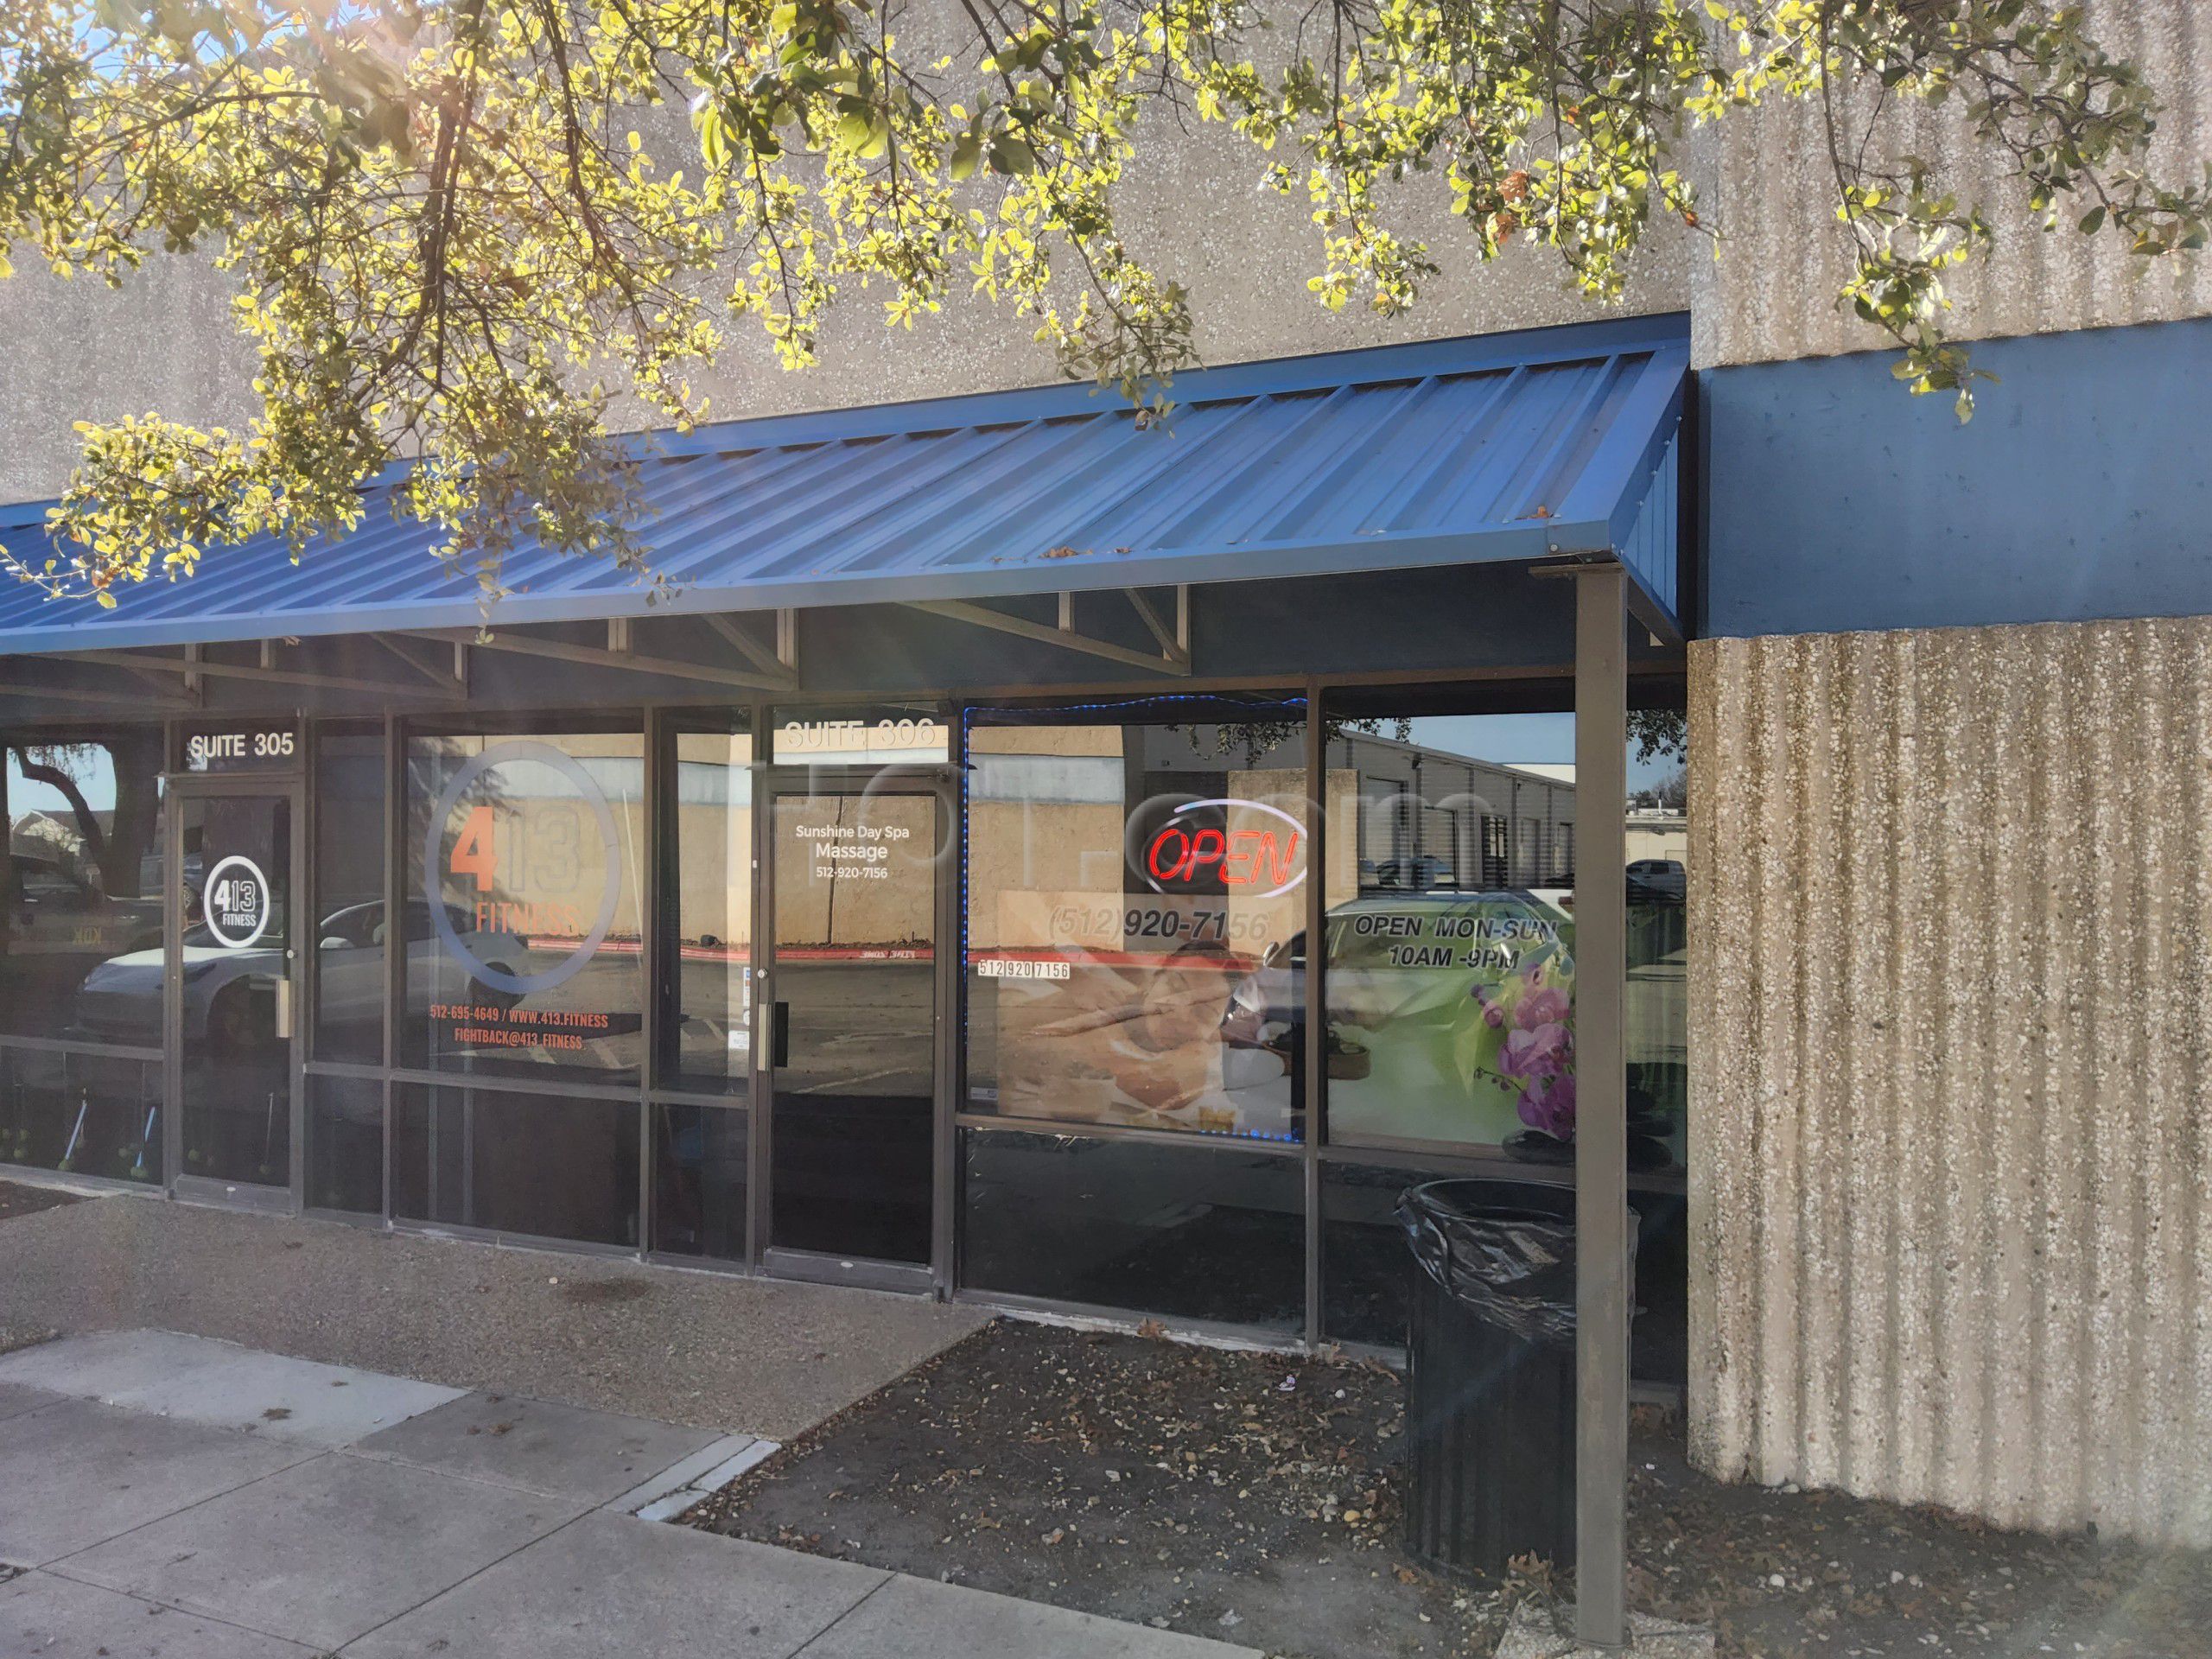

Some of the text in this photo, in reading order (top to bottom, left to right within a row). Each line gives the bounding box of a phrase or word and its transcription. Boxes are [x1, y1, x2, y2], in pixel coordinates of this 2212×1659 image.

[190, 733, 294, 758] SUITE 305
[784, 718, 936, 748] SUITE 306
[796, 825, 910, 843] Sunshine Day Spa
[450, 805, 580, 893] 413
[815, 842, 889, 861] Massage
[1149, 829, 1299, 885] OPEN
[816, 867, 888, 879] 512-920-7156
[214, 880, 256, 912] 413
[222, 912, 257, 927] FITNESS
[475, 900, 581, 936] FITNESS
[1048, 906, 1270, 943] (512)920-7156
[1354, 915, 1557, 941] OPEN MON-SUN
[1389, 944, 1452, 968] 10AM
[429, 1004, 499, 1022] 512-695-4649
[508, 1010, 608, 1028] WWW.413.FITNESS
[454, 1027, 582, 1050] FIGHTBACK@413FITNESS
